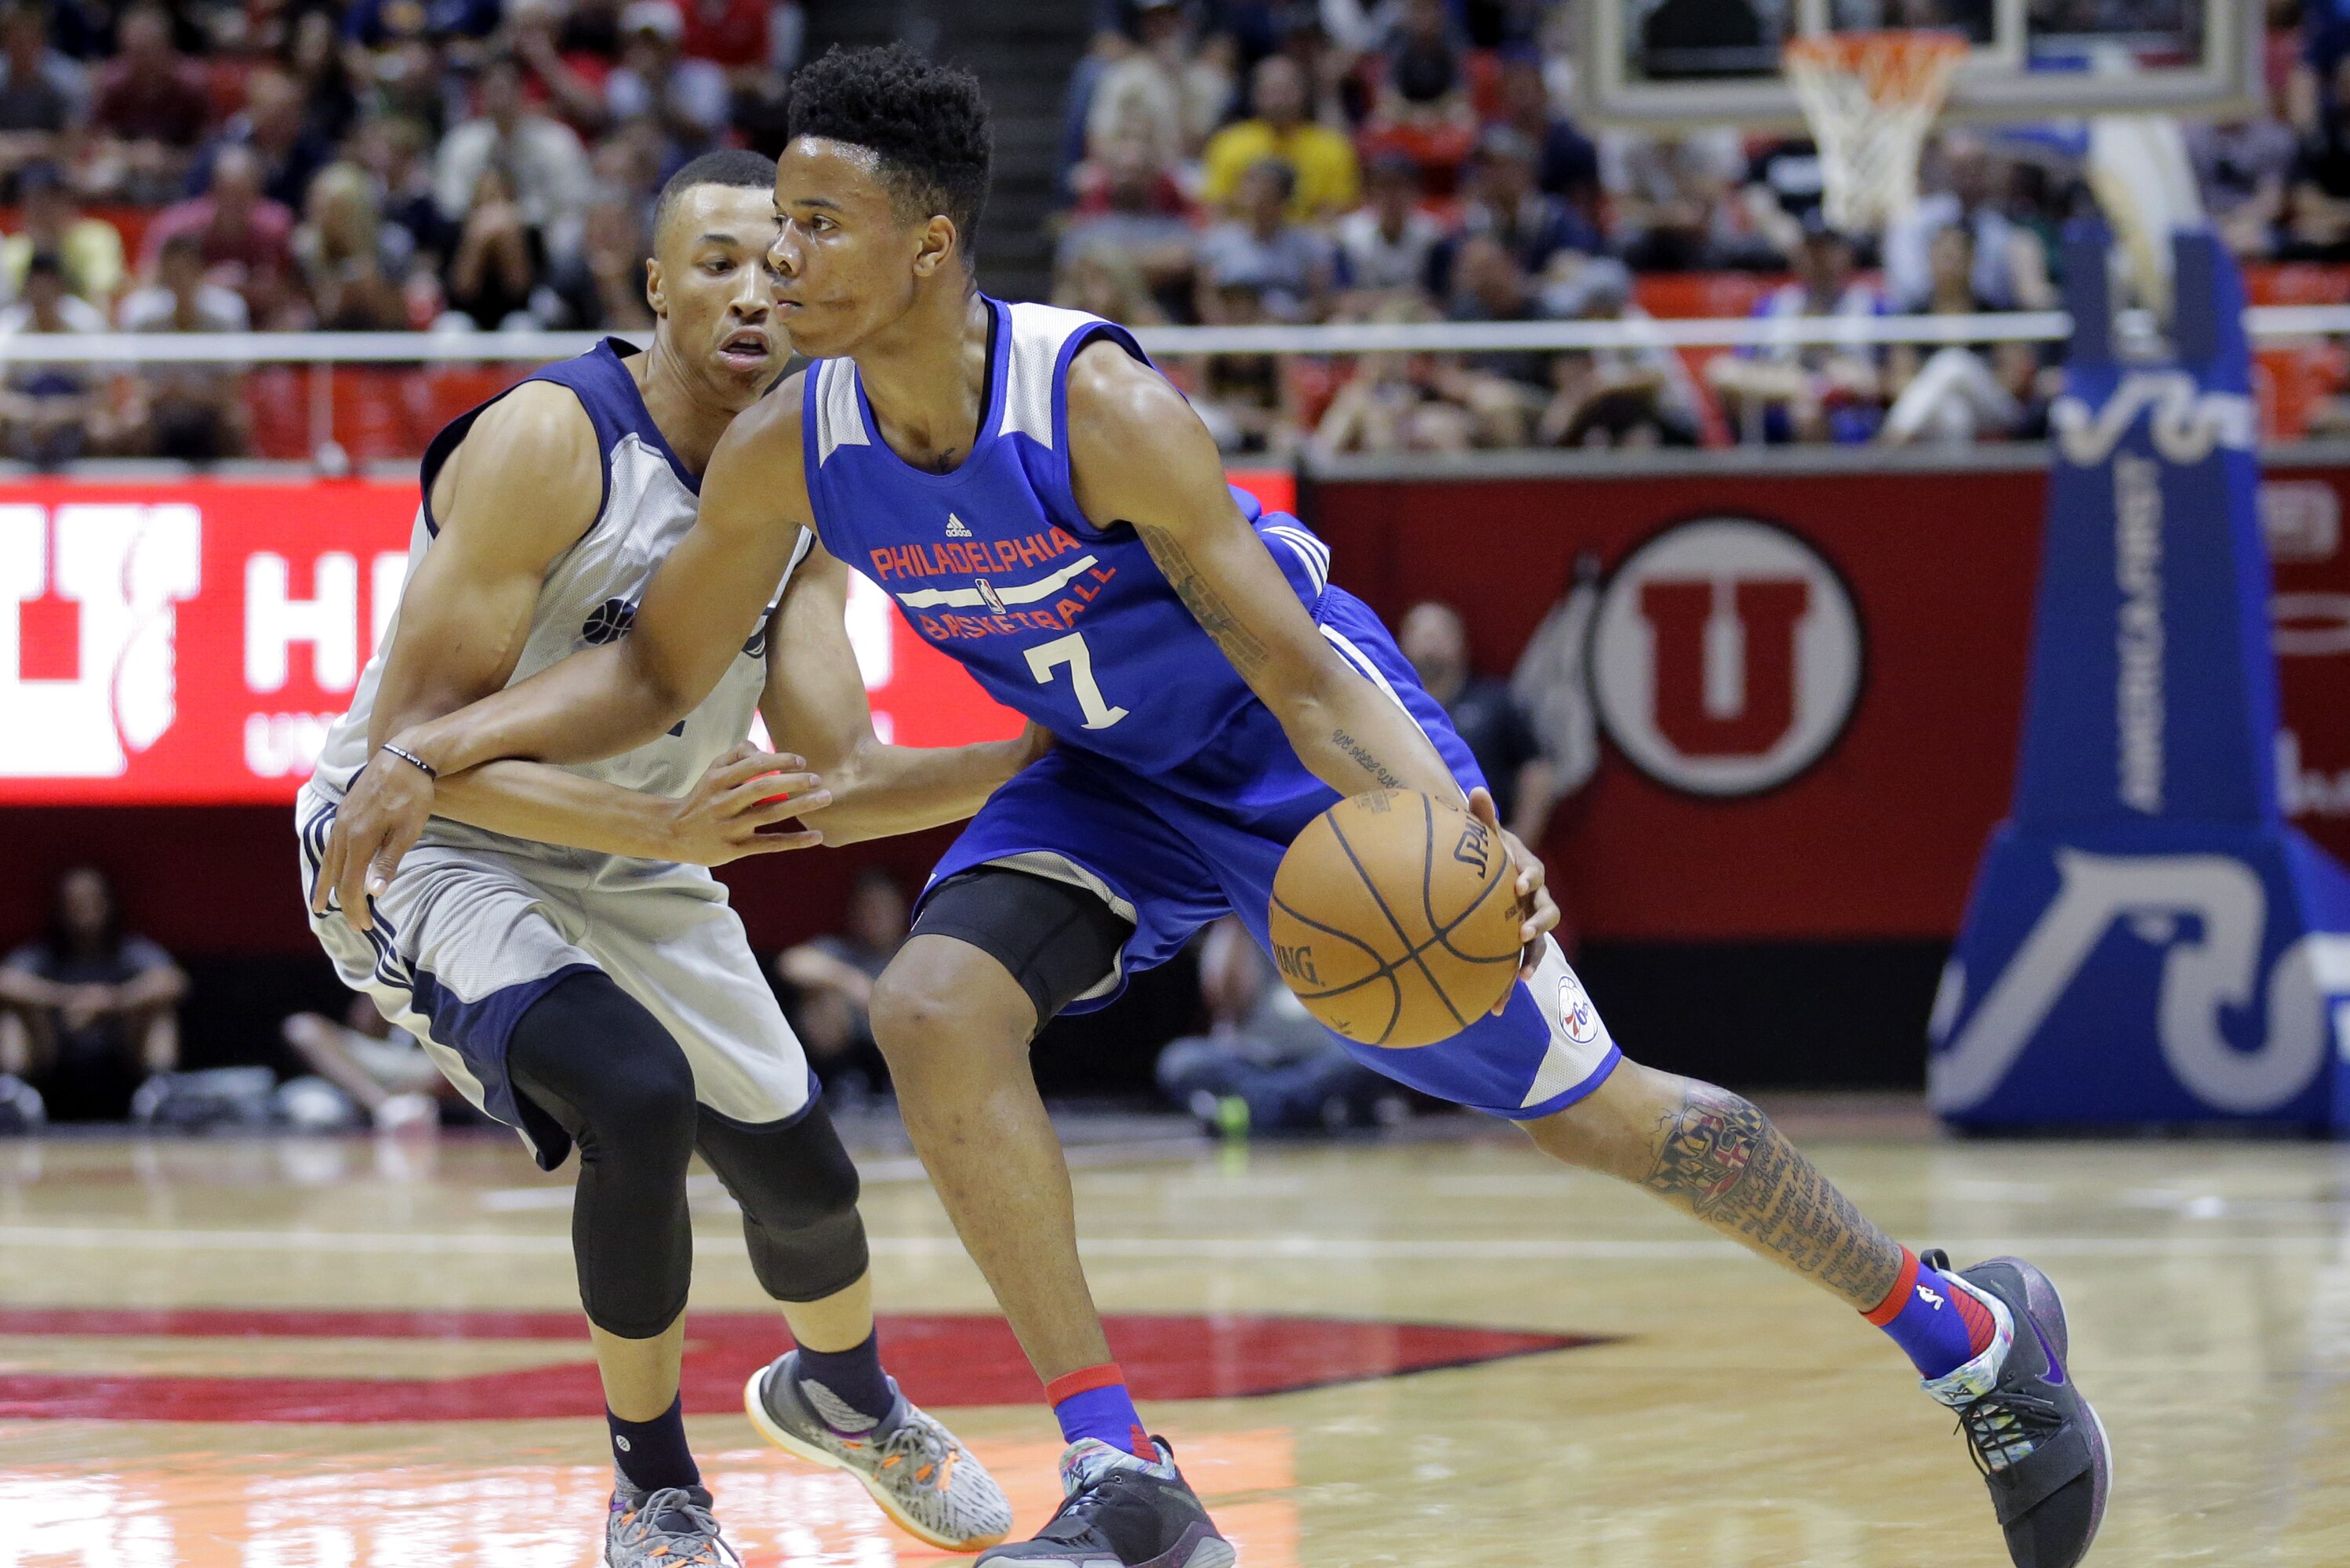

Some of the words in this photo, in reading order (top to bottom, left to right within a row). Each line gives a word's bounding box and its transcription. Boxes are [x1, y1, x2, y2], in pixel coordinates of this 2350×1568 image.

[870, 526, 1083, 581] PHILADELPHIA
[918, 565, 1117, 641] BASKETBALL
[1023, 631, 1130, 731] 7
[1640, 578, 1811, 757] U
